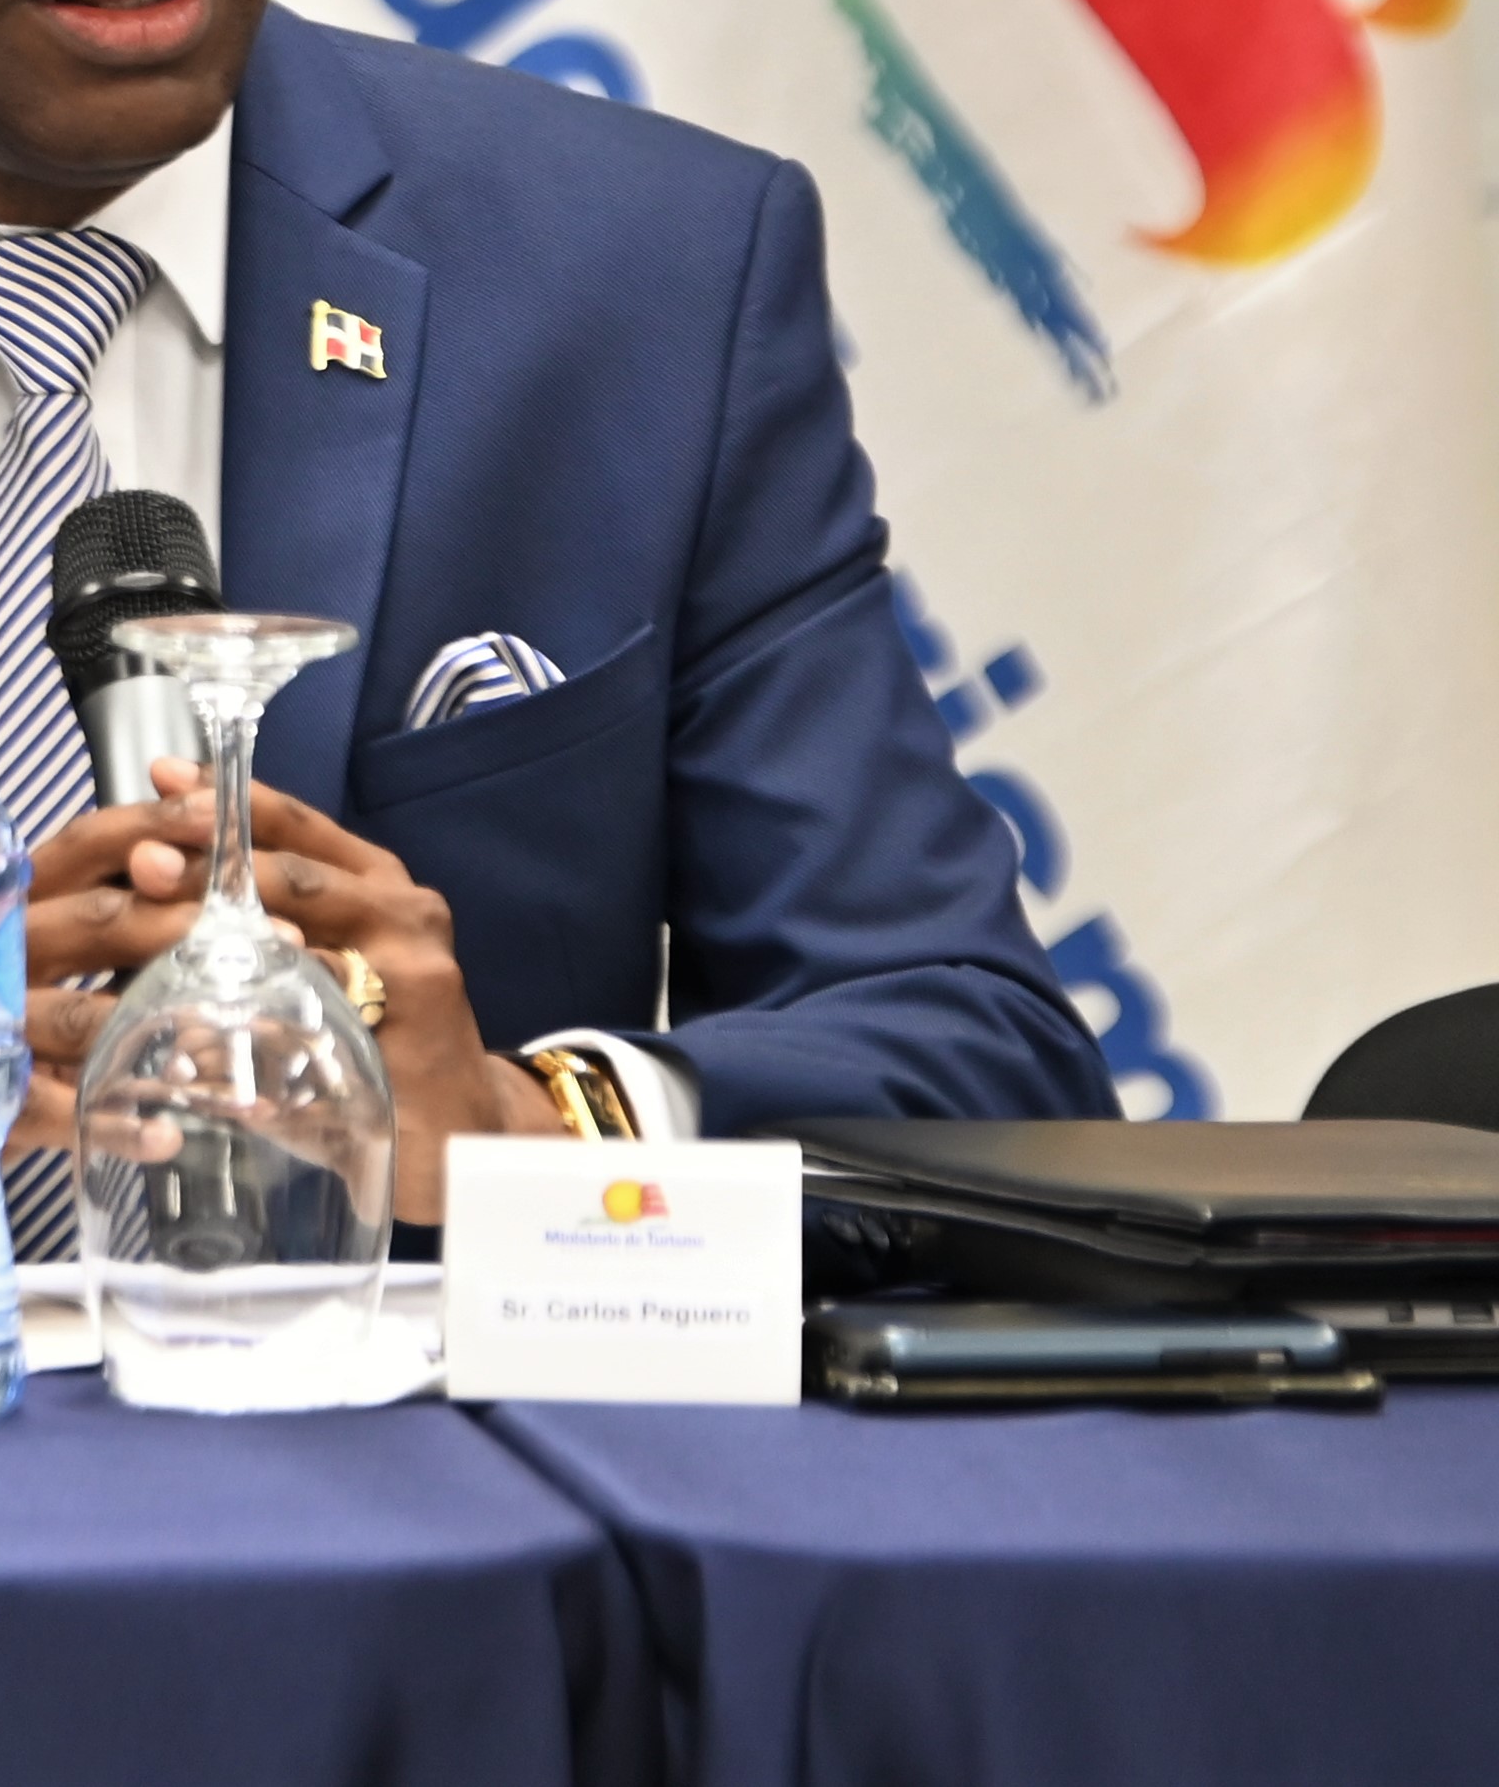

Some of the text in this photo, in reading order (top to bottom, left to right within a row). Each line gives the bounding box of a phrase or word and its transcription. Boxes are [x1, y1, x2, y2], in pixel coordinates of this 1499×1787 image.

[502, 1298, 751, 1328] Sr. Carlos Peguero
